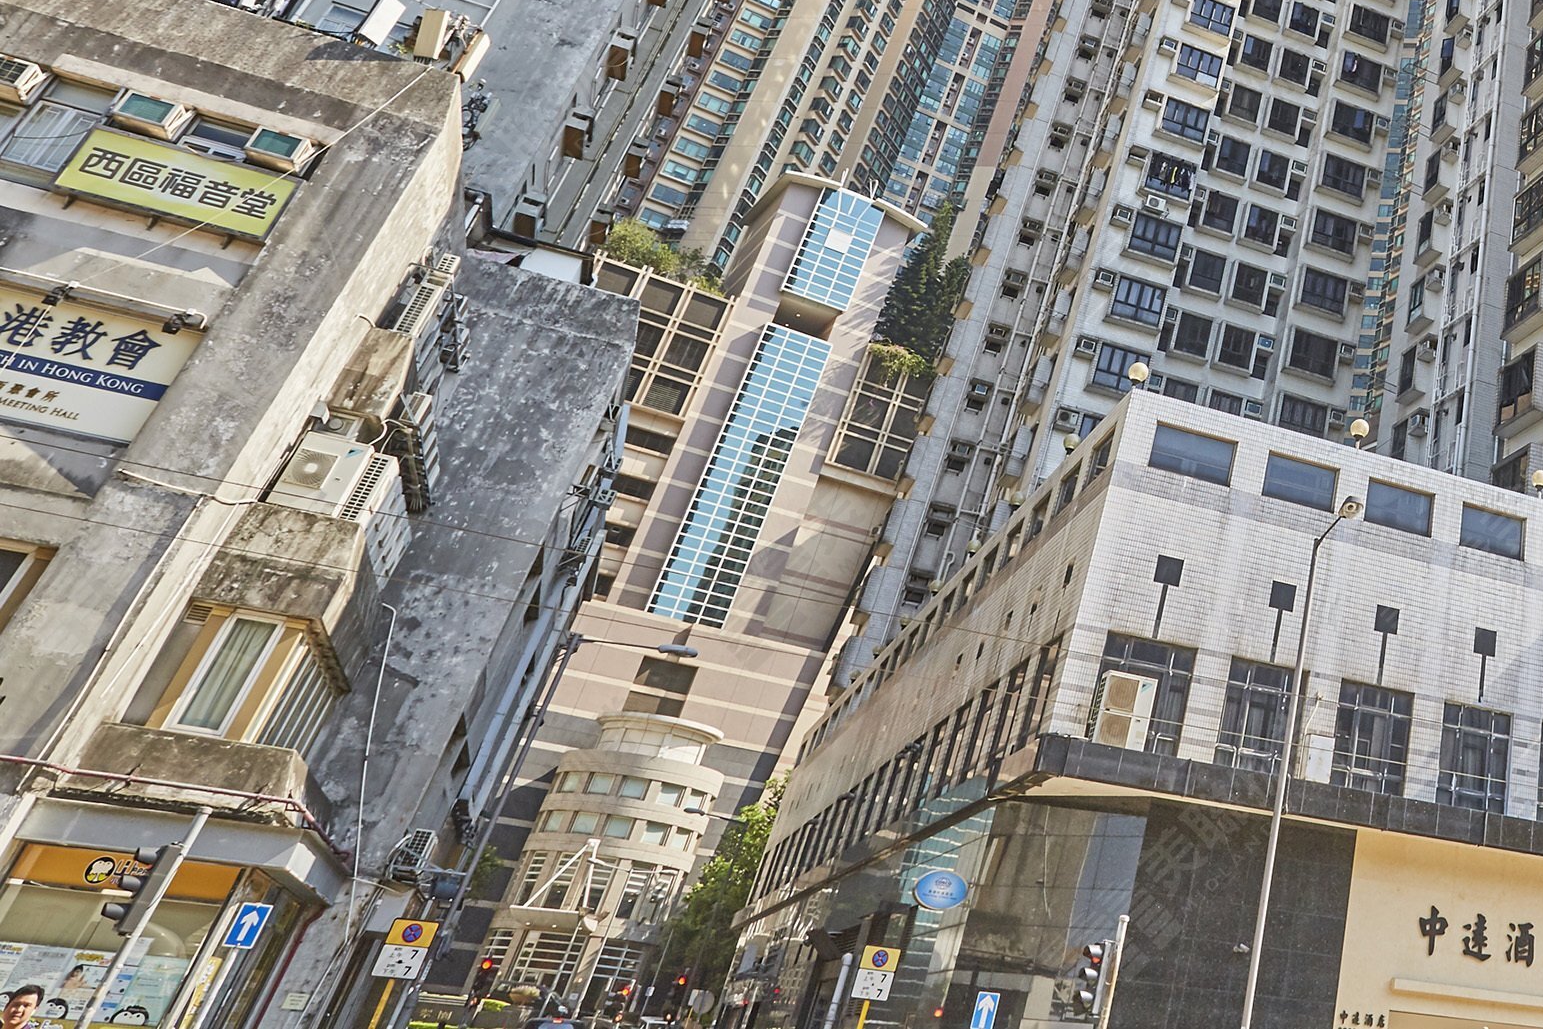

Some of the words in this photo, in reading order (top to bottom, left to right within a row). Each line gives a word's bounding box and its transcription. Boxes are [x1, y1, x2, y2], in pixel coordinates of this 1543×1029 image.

[79, 146, 277, 220] 西區福音堂
[0, 303, 162, 370] 港教會
[18, 359, 39, 371] IN
[41, 363, 93, 383] HONG
[95, 374, 144, 394] KONG
[50, 407, 80, 420] HALL
[410, 949, 420, 960] 7
[403, 965, 412, 977] 7
[881, 973, 888, 983] 7
[876, 988, 883, 998] 7
